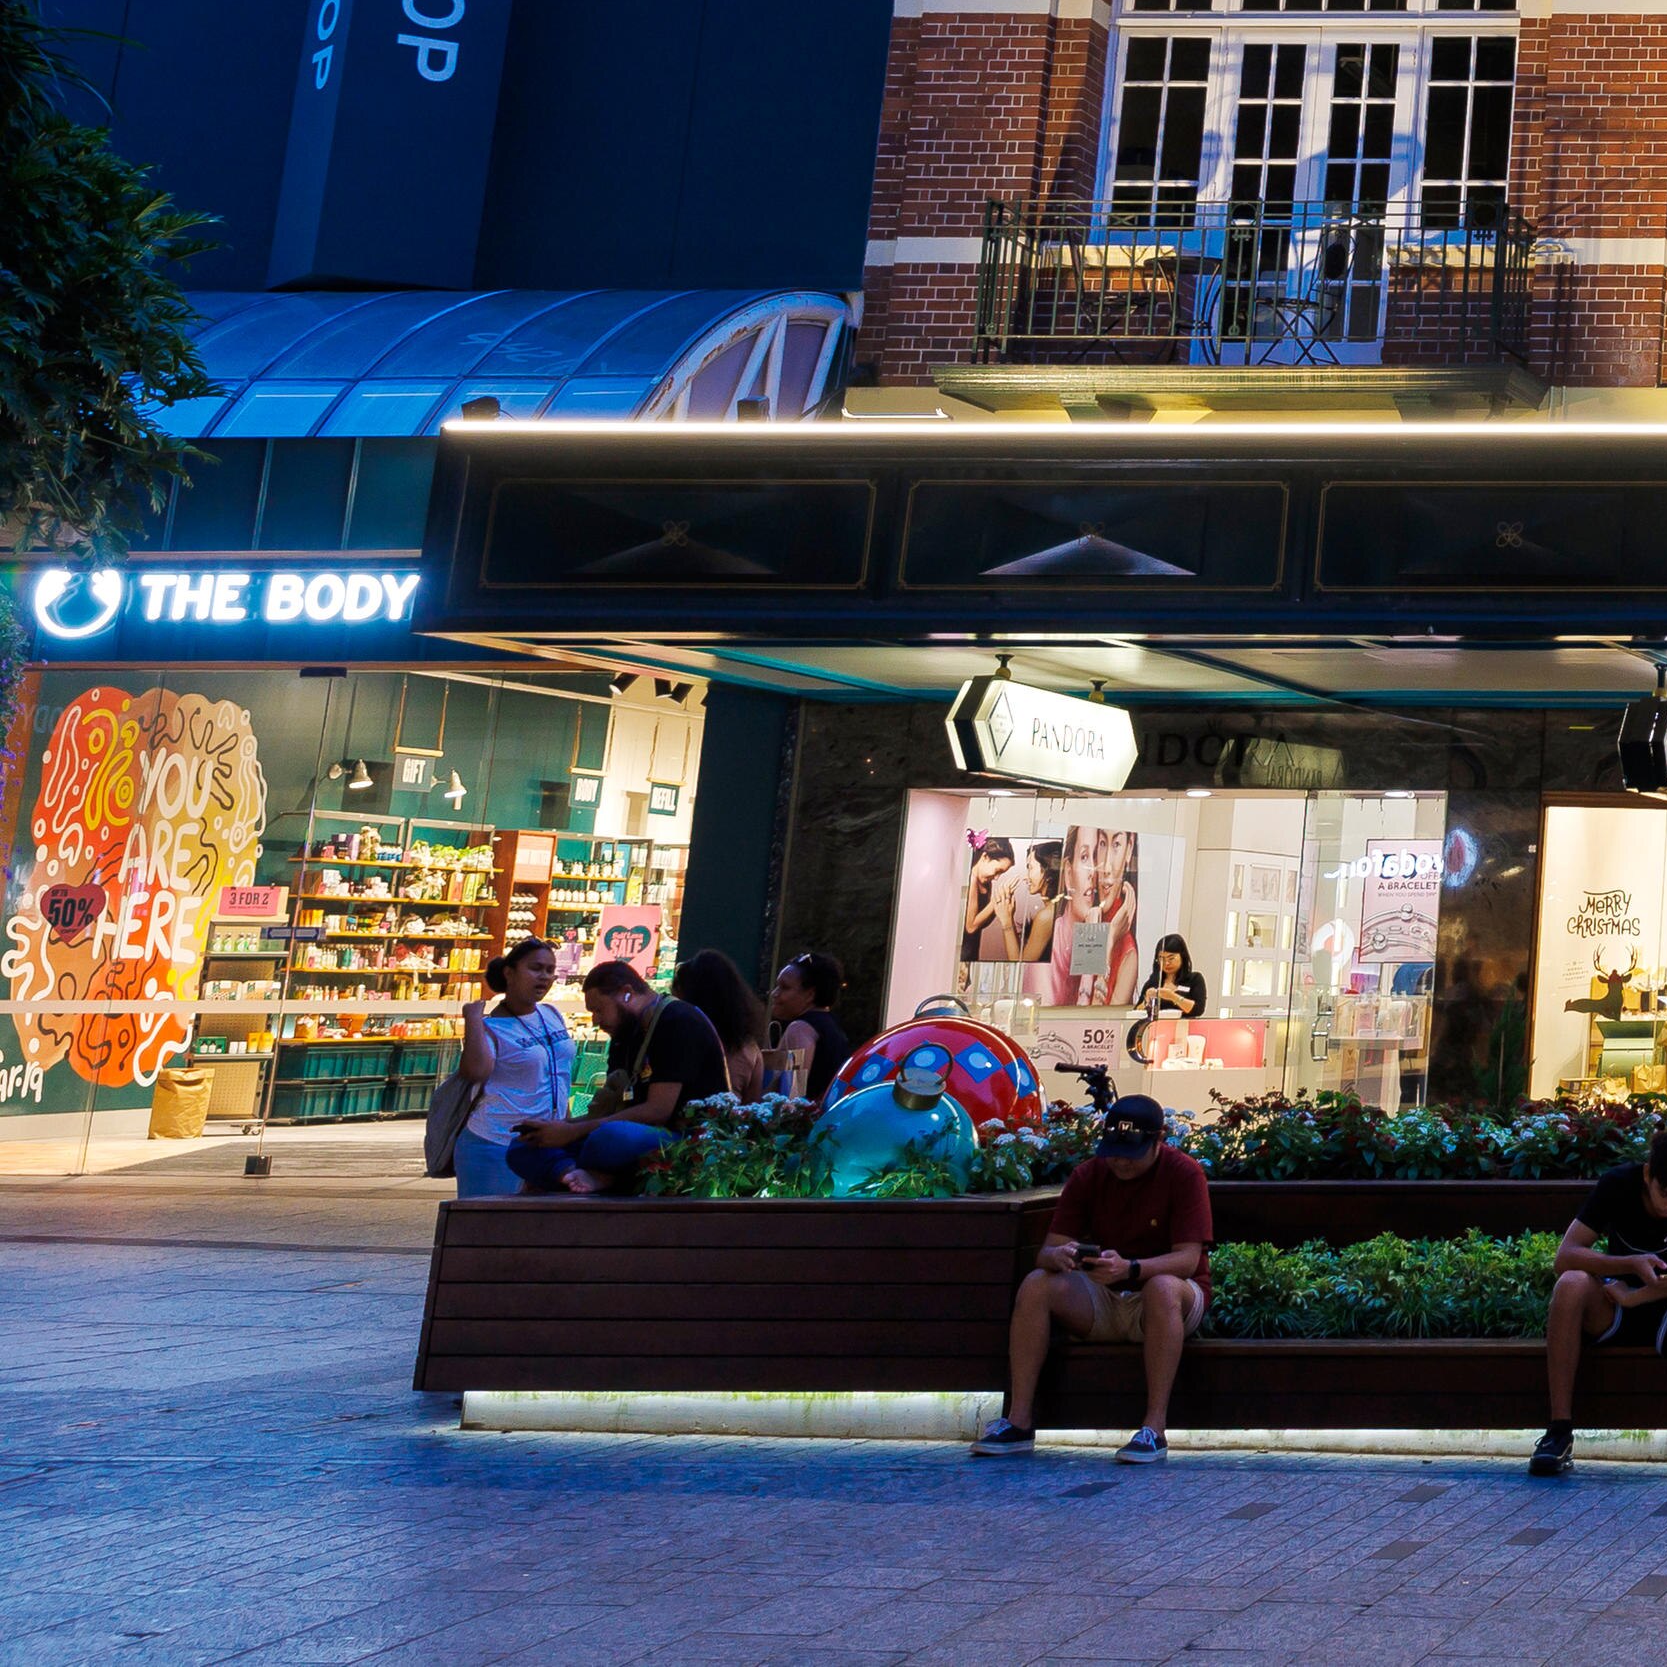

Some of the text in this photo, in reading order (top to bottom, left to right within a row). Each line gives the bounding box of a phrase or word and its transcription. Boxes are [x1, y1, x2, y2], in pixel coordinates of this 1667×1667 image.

[142, 574, 421, 622] THE BODY
[1030, 717, 1106, 760] PANDORA
[140, 747, 214, 820] YOU
[402, 759, 426, 783] GIFT
[119, 822, 200, 891] ARE
[229, 893, 270, 905] 3 FOR 2
[1387, 881, 1438, 890] BRACELET
[49, 897, 95, 929] 50%
[92, 890, 202, 968] HERE
[609, 938, 643, 958] SALE
[1083, 1029, 1115, 1044] 50%
